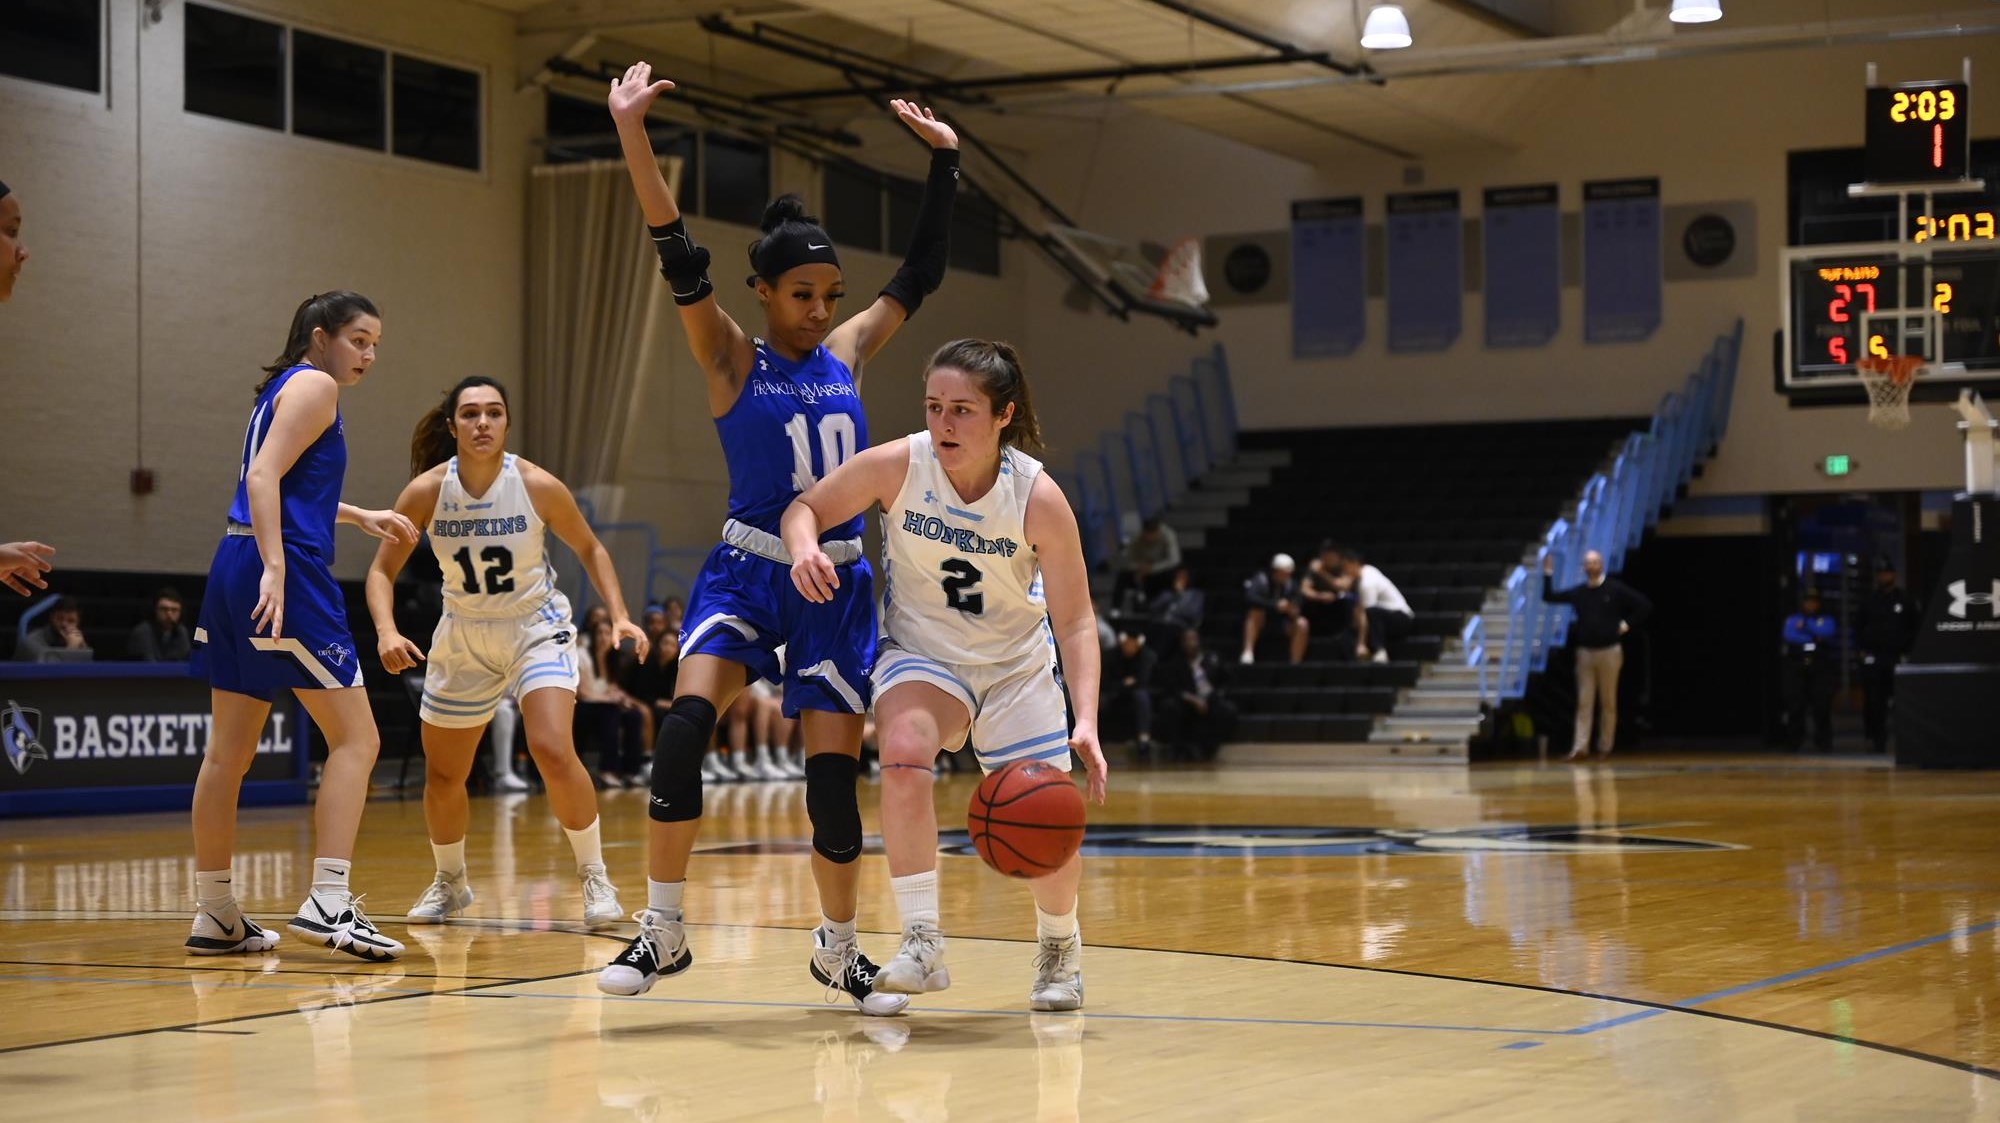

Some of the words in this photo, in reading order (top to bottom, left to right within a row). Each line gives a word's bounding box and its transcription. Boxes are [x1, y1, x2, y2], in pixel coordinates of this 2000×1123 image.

[1891, 90, 1955, 122] 2:03
[1933, 124, 1942, 167] 1
[1829, 285, 1875, 323] 27
[1934, 283, 1952, 313] 2
[785, 412, 857, 492] 10
[434, 515, 527, 537] HOPKINS
[903, 509, 1018, 558] HOPKINS
[453, 546, 515, 595] 12
[940, 556, 984, 616] 2
[54, 713, 292, 759] BASKETL
